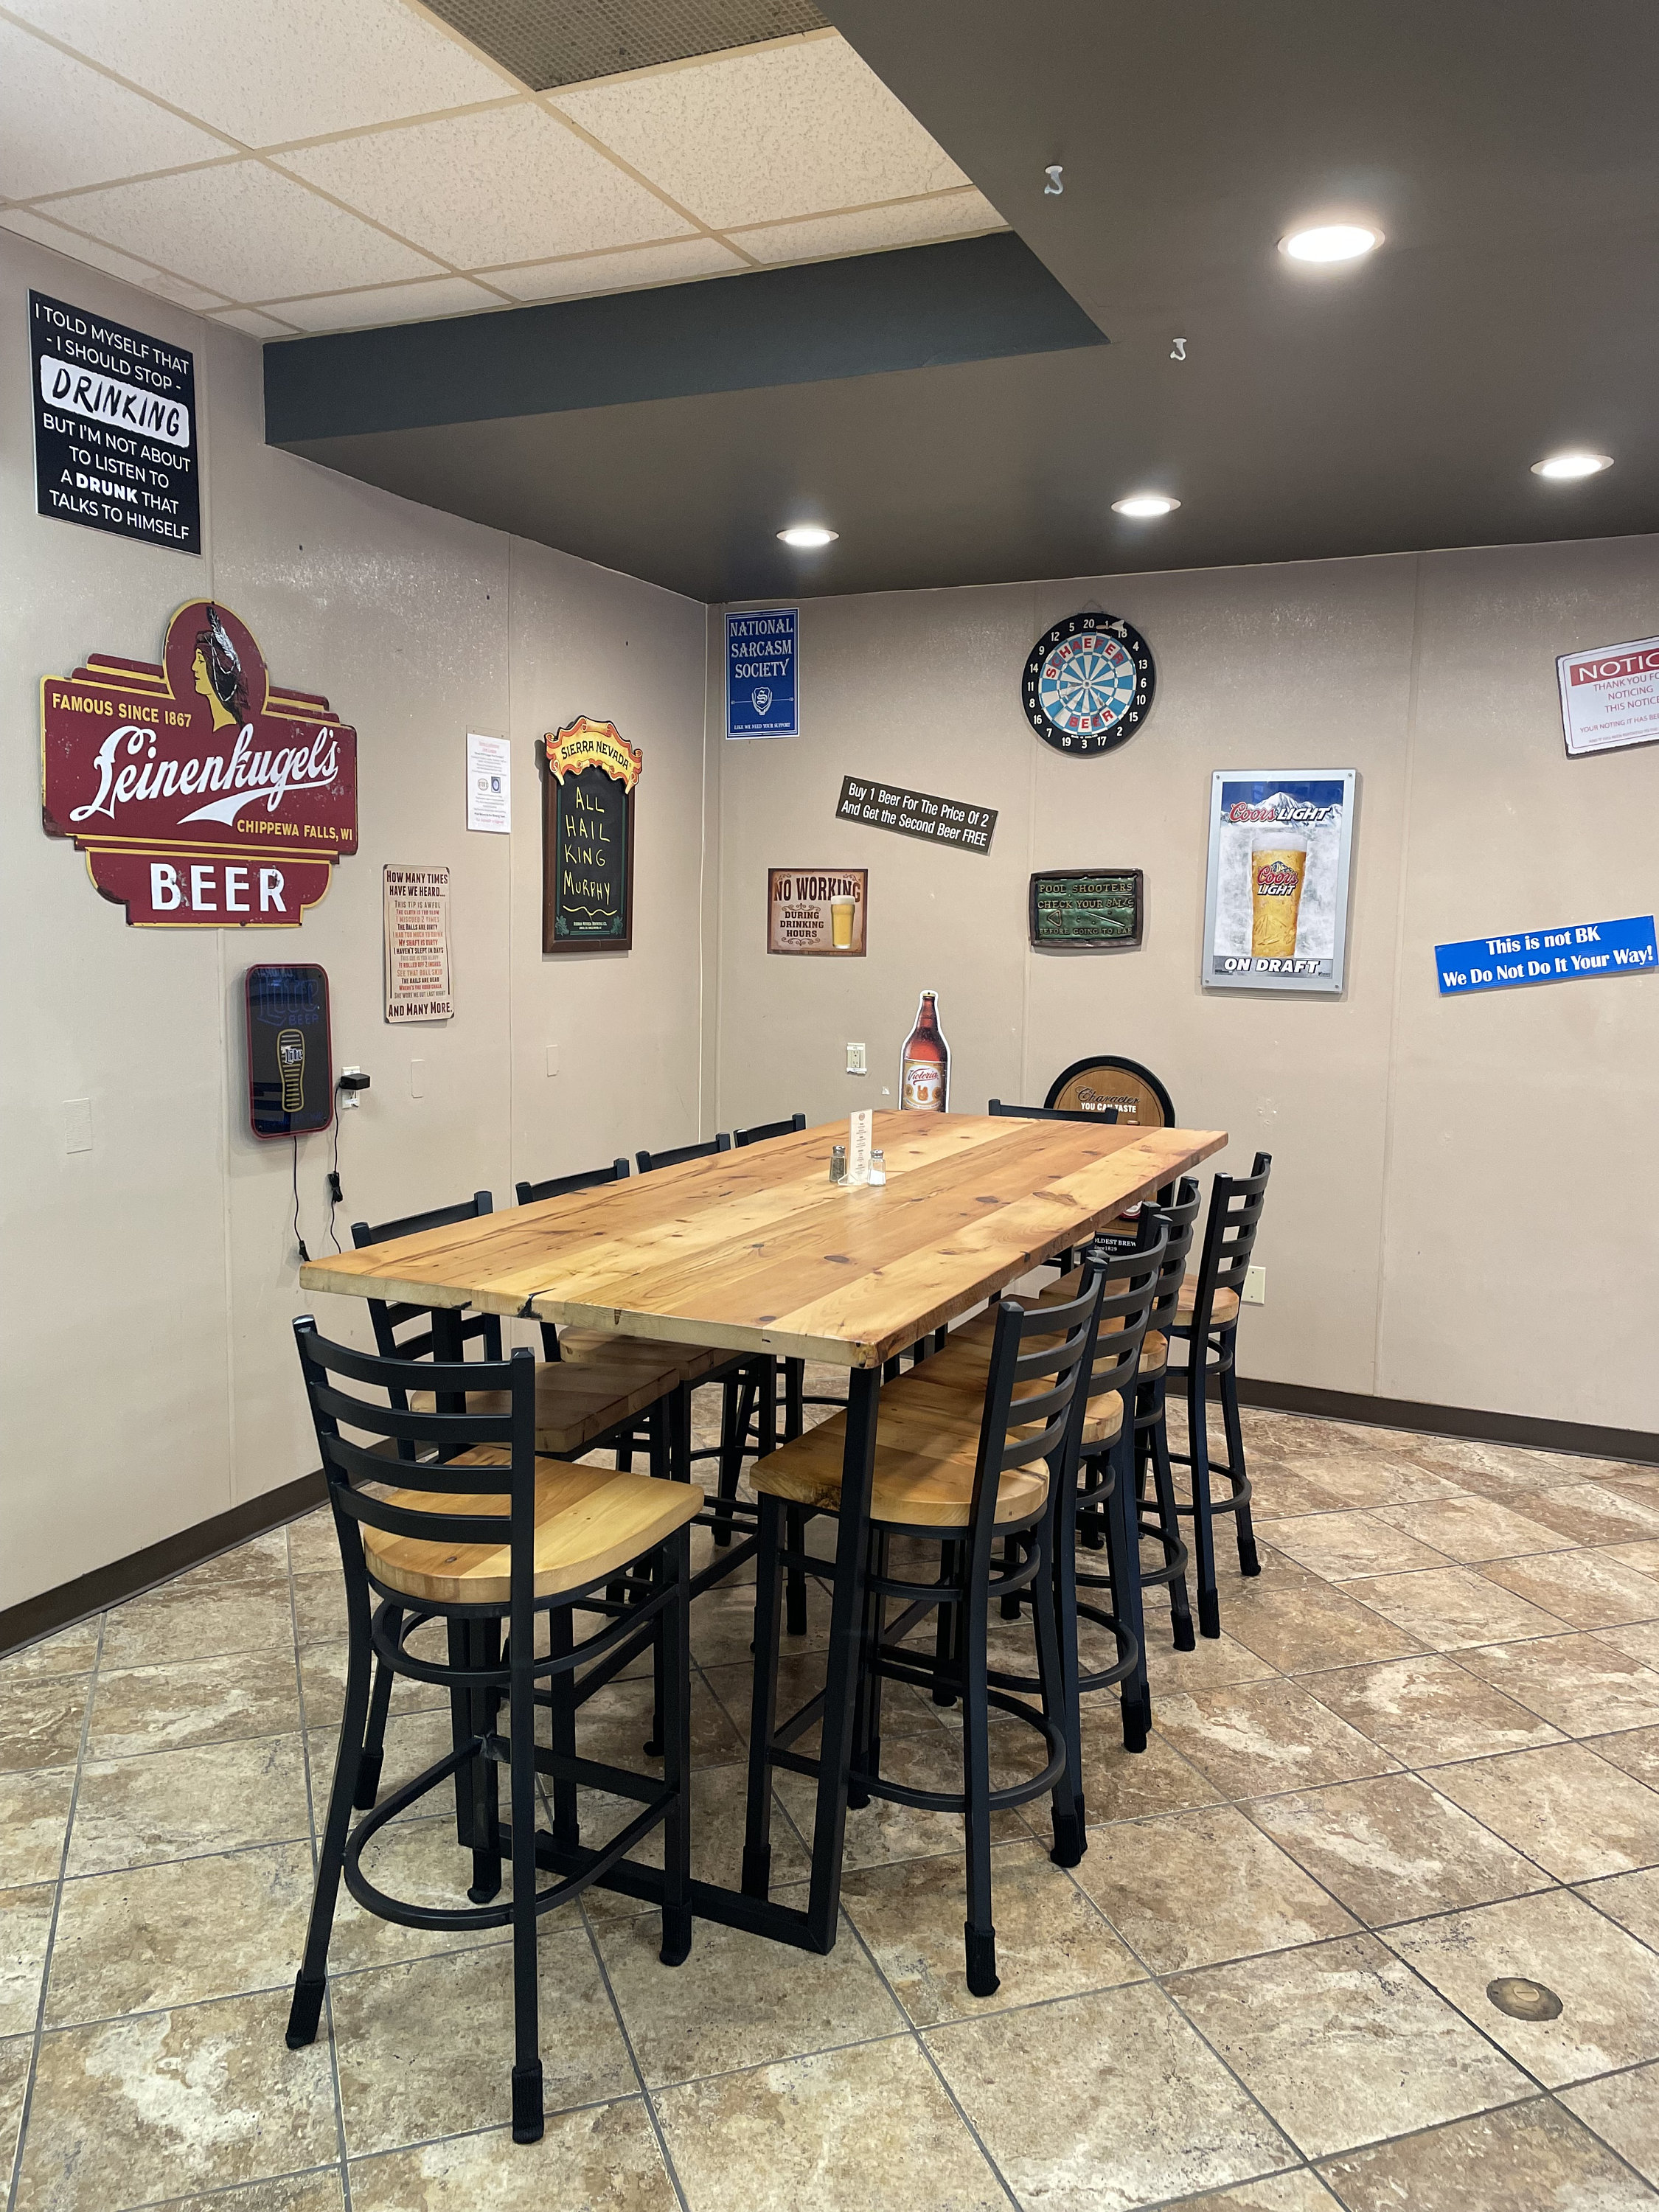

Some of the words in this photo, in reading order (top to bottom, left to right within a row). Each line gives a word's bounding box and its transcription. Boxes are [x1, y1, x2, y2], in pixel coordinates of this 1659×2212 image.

[35, 302, 39, 319] I
[44, 306, 87, 335] TOLD
[91, 324, 149, 359] MYSELF
[152, 348, 189, 375] THAT
[57, 336, 60, 351] I
[66, 340, 131, 375] SHOULD
[135, 366, 172, 389] STOP
[52, 368, 180, 437] DRINKING
[44, 412, 75, 437] BUT
[80, 425, 101, 445] I'M
[106, 433, 136, 456] NOT
[141, 445, 191, 472] ABOUT
[69, 445, 91, 465] TO
[95, 456, 145, 482] LISTEN
[149, 470, 170, 488] TO
[60, 470, 73, 485] A
[76, 473, 139, 504] DRUNK
[141, 491, 178, 515] THAT
[49, 490, 98, 516] TALKS
[102, 504, 122, 522] TO
[127, 509, 189, 540] HIMSELF
[730, 618, 793, 637] NATIONAL
[1069, 623, 1074, 631] 5
[1083, 619, 1094, 628] 20
[1051, 632, 1059, 641] 12
[731, 639, 792, 658] SARCASM
[1039, 646, 1044, 655] 9
[1133, 641, 1139, 651] 4
[1046, 638, 1124, 678] SCHAEFER
[1139, 660, 1147, 669] 13
[735, 658, 790, 678] SOCIETY
[1030, 664, 1038, 672] 14
[1028, 682, 1034, 691] 11
[1141, 678, 1147, 688] 6
[1593, 678, 1625, 692] THANK
[1627, 675, 1646, 685] YOU
[1136, 695, 1146, 705] 10
[1608, 685, 1653, 700] NOTICING
[52, 692, 114, 717] FAMOUS
[118, 704, 160, 723] SINCE
[164, 710, 192, 728] 1867
[1029, 698, 1035, 708] 8
[1604, 703, 1625, 713] THIS
[1034, 715, 1042, 724] 16
[1068, 710, 1114, 728] BEER
[1130, 712, 1138, 722] 15
[1046, 728, 1052, 737] 7
[1117, 727, 1123, 736] 2
[1580, 725, 1599, 733] YOUR
[1600, 720, 1625, 729] NOTING
[1062, 737, 1071, 746] 19
[1082, 740, 1088, 748] 3
[1097, 737, 1106, 746] 17
[560, 740, 594, 760] SIERRA
[596, 741, 629, 770] NEVADA
[849, 782, 867, 800] Buy
[871, 787, 874, 800] 1
[878, 790, 901, 806] Beer
[902, 795, 919, 810] For
[922, 799, 938, 815] The
[941, 804, 964, 821] Price
[968, 811, 980, 825] Of
[981, 814, 989, 827] 2
[1229, 801, 1276, 823] Coors
[1276, 807, 1331, 821] LIGHT
[236, 819, 300, 837] CHIPPEWA
[303, 825, 338, 841] FALLS,
[341, 830, 353, 841] WI
[565, 814, 611, 843] HAIL
[841, 800, 860, 815] And
[863, 805, 879, 821] Get
[881, 810, 896, 824] the
[899, 813, 935, 834] Second
[937, 822, 961, 840] Beer
[962, 829, 988, 846] FREE
[564, 844, 605, 866] KING
[406, 872, 425, 883] MANY
[427, 874, 448, 883] TIMES
[1256, 864, 1298, 886] Coors
[150, 863, 287, 913] BEER
[389, 886, 406, 895] HAVE
[408, 886, 417, 896] WE
[773, 879, 791, 901] NO
[796, 877, 860, 902] WORKING
[1040, 885, 1066, 893] POOL
[1072, 883, 1133, 892] SHOOTERS
[1257, 884, 1296, 896] LIGHT
[1037, 900, 1073, 908] CHECK
[1077, 900, 1103, 908] YOUR
[1107, 898, 1134, 908] BALLS
[780, 920, 824, 928] DRINKING
[1485, 939, 1521, 956] This
[1525, 935, 1540, 950] is
[1544, 931, 1572, 947] not
[1575, 926, 1601, 944] BK
[1224, 958, 1252, 971] ON
[1256, 959, 1320, 973] DRAFT
[1442, 972, 1467, 987] We
[1470, 969, 1492, 984] Do
[1497, 964, 1525, 981] Not
[1528, 961, 1551, 976] Do
[1554, 958, 1568, 973] It
[1571, 953, 1610, 970] Your
[1613, 945, 1653, 966] Way!
[389, 1004, 404, 1017] AND
[407, 1003, 428, 1015] MANY
[1075, 1085, 1141, 1104] Character
